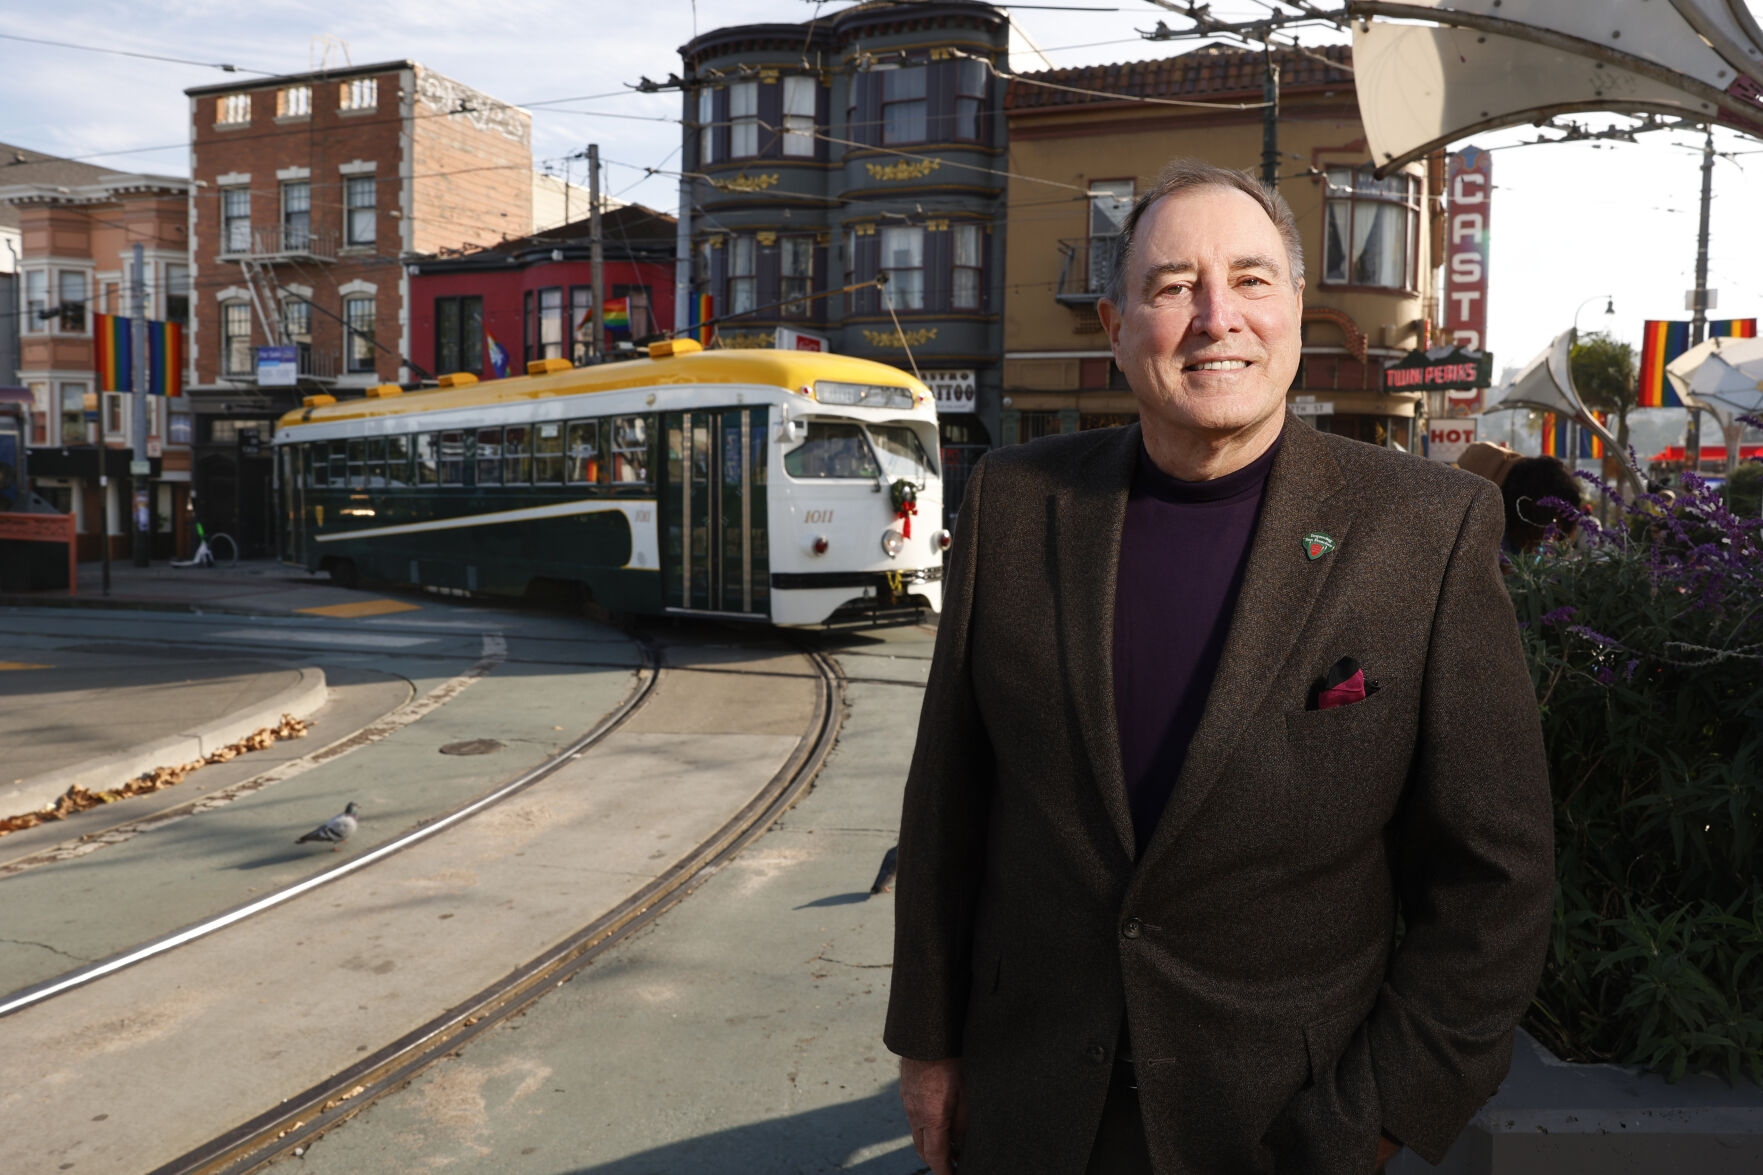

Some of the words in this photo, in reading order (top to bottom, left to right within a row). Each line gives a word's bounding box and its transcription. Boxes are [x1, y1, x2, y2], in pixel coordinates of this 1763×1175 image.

[920, 372, 969, 381] ASTRO
[1386, 369, 1422, 387] TWIN
[1424, 362, 1477, 384] PEAKS
[929, 384, 974, 402] TTOO
[1431, 429, 1474, 444] HOT
[803, 509, 833, 524] 1011
